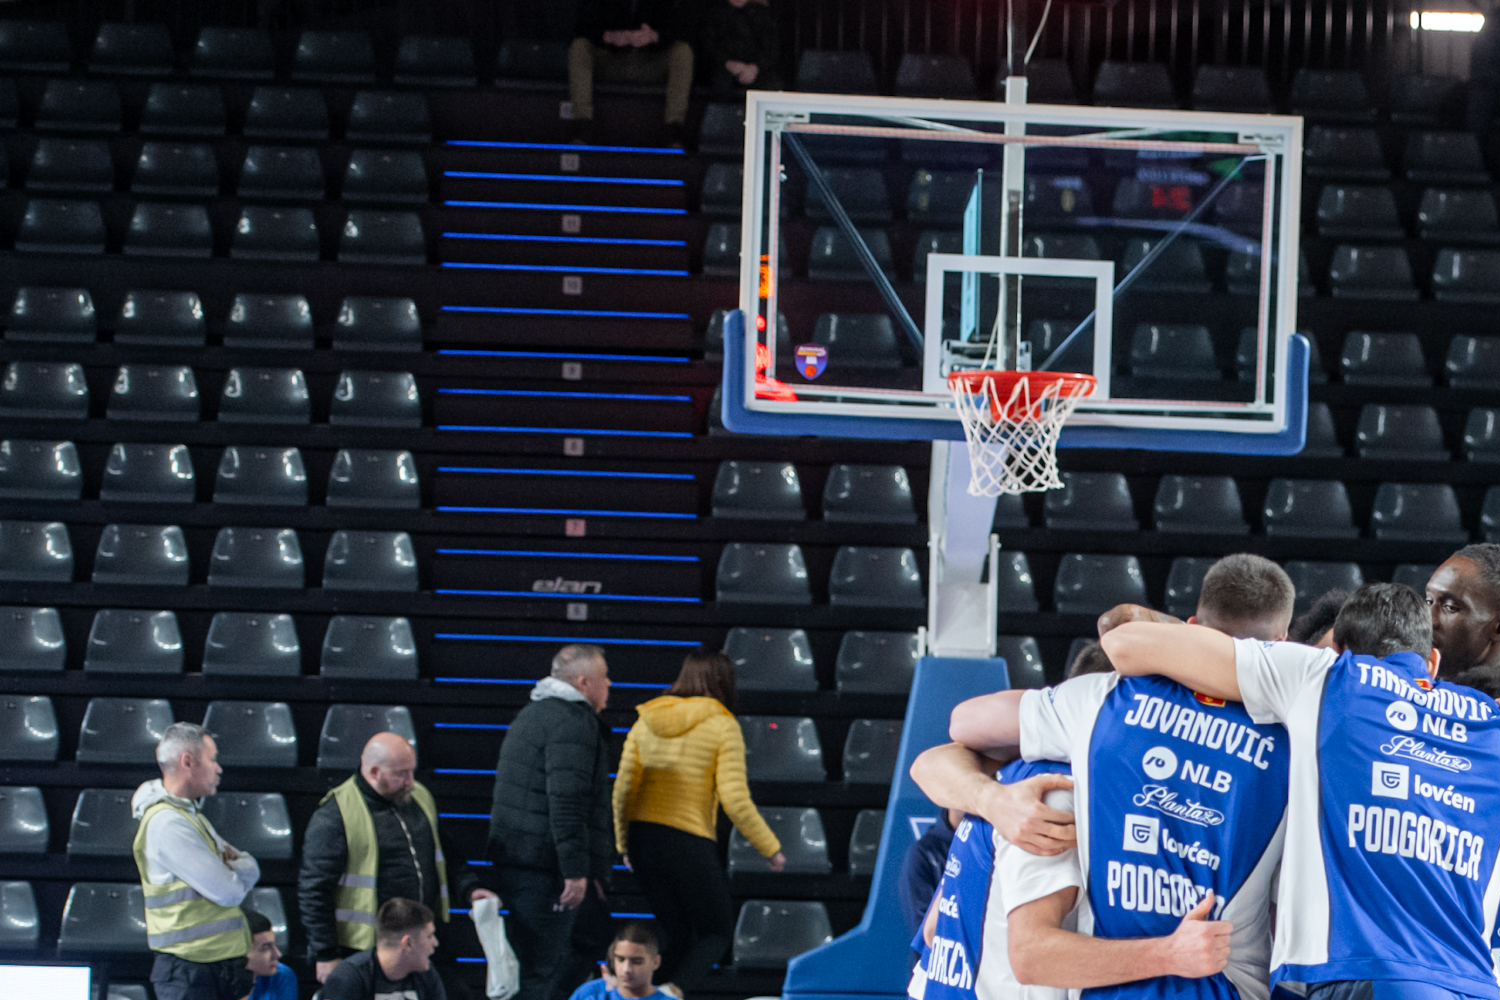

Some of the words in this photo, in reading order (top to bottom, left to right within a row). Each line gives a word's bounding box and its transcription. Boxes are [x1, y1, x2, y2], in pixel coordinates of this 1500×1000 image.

[1124, 694, 1275, 770] JOVANOVIĆ
[1422, 713, 1468, 743] NLB
[1380, 735, 1472, 773] Plantaže
[1180, 759, 1233, 793] NLB
[1414, 774, 1476, 814] lovćen
[1132, 784, 1225, 827] Plantaže
[1162, 829, 1221, 870] lovćen
[1348, 803, 1484, 881] PODGORICA
[1107, 860, 1226, 920] PODGOR
